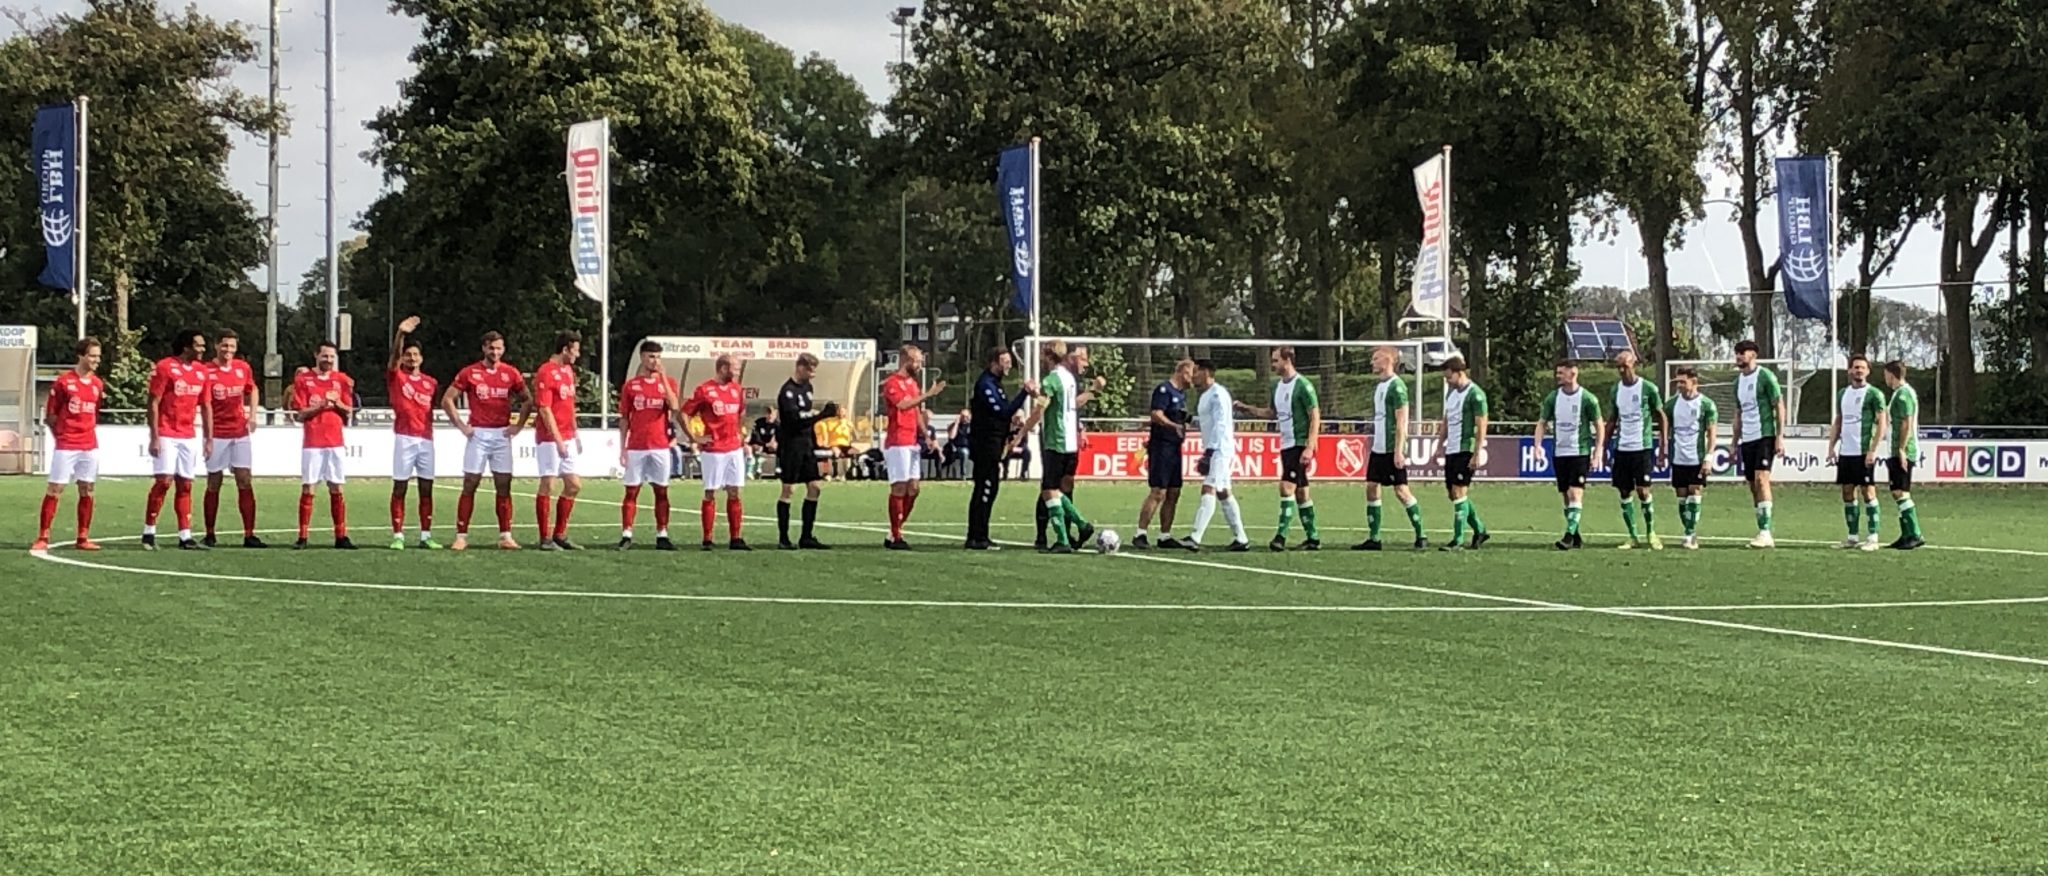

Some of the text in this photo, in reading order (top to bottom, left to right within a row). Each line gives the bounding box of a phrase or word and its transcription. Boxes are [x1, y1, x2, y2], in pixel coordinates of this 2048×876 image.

[711, 340, 753, 348] TEAM
[768, 340, 809, 349] BRAND
[823, 341, 867, 350] EVENT
[823, 351, 866, 359] CONCEPT
[1249, 439, 1265, 453] IS
[1093, 453, 1128, 476] DE
[1783, 452, 1819, 471] mijn
[1939, 450, 2022, 473] MCD
